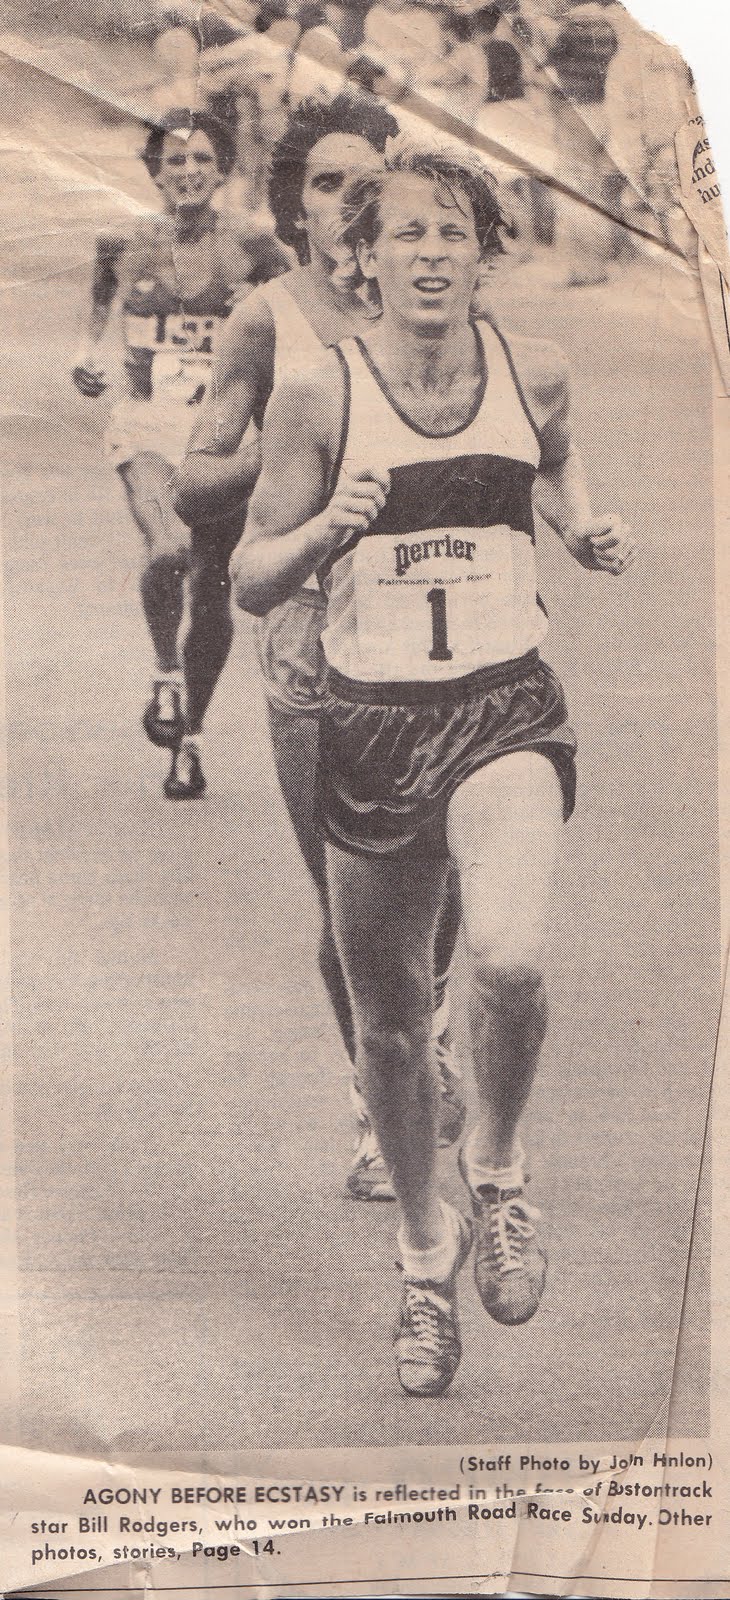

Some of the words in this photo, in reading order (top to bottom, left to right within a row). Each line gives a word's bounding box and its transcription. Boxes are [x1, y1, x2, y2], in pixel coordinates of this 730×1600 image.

[378, 578, 430, 586] Falmouth
[433, 576, 462, 585] Road
[466, 573, 492, 582] Race
[426, 587, 453, 661] 1
[459, 1455, 511, 1474] (Staff
[519, 1455, 570, 1471] Photo
[579, 1454, 600, 1474] by
[83, 1488, 161, 1505] AGONY
[171, 1487, 246, 1504] BEFORE
[255, 1486, 344, 1502] ECSTASY
[353, 1486, 367, 1502] is
[375, 1484, 460, 1501] reflected
[468, 1483, 486, 1501] in
[496, 1483, 526, 1498] the
[583, 1482, 602, 1496] of
[31, 1517, 68, 1533] star
[79, 1516, 108, 1533] Bill
[120, 1515, 203, 1537] Rodgers,
[215, 1515, 257, 1531] who
[269, 1516, 311, 1528] won
[322, 1514, 353, 1527] the
[364, 1507, 457, 1524] Falmouth
[468, 1502, 516, 1521] Road
[527, 1502, 572, 1521] Race
[658, 1508, 713, 1526] Other
[31, 1545, 103, 1565] photos,
[113, 1542, 181, 1561] stories,
[192, 1540, 241, 1560] Page
[251, 1539, 281, 1556] 14.
